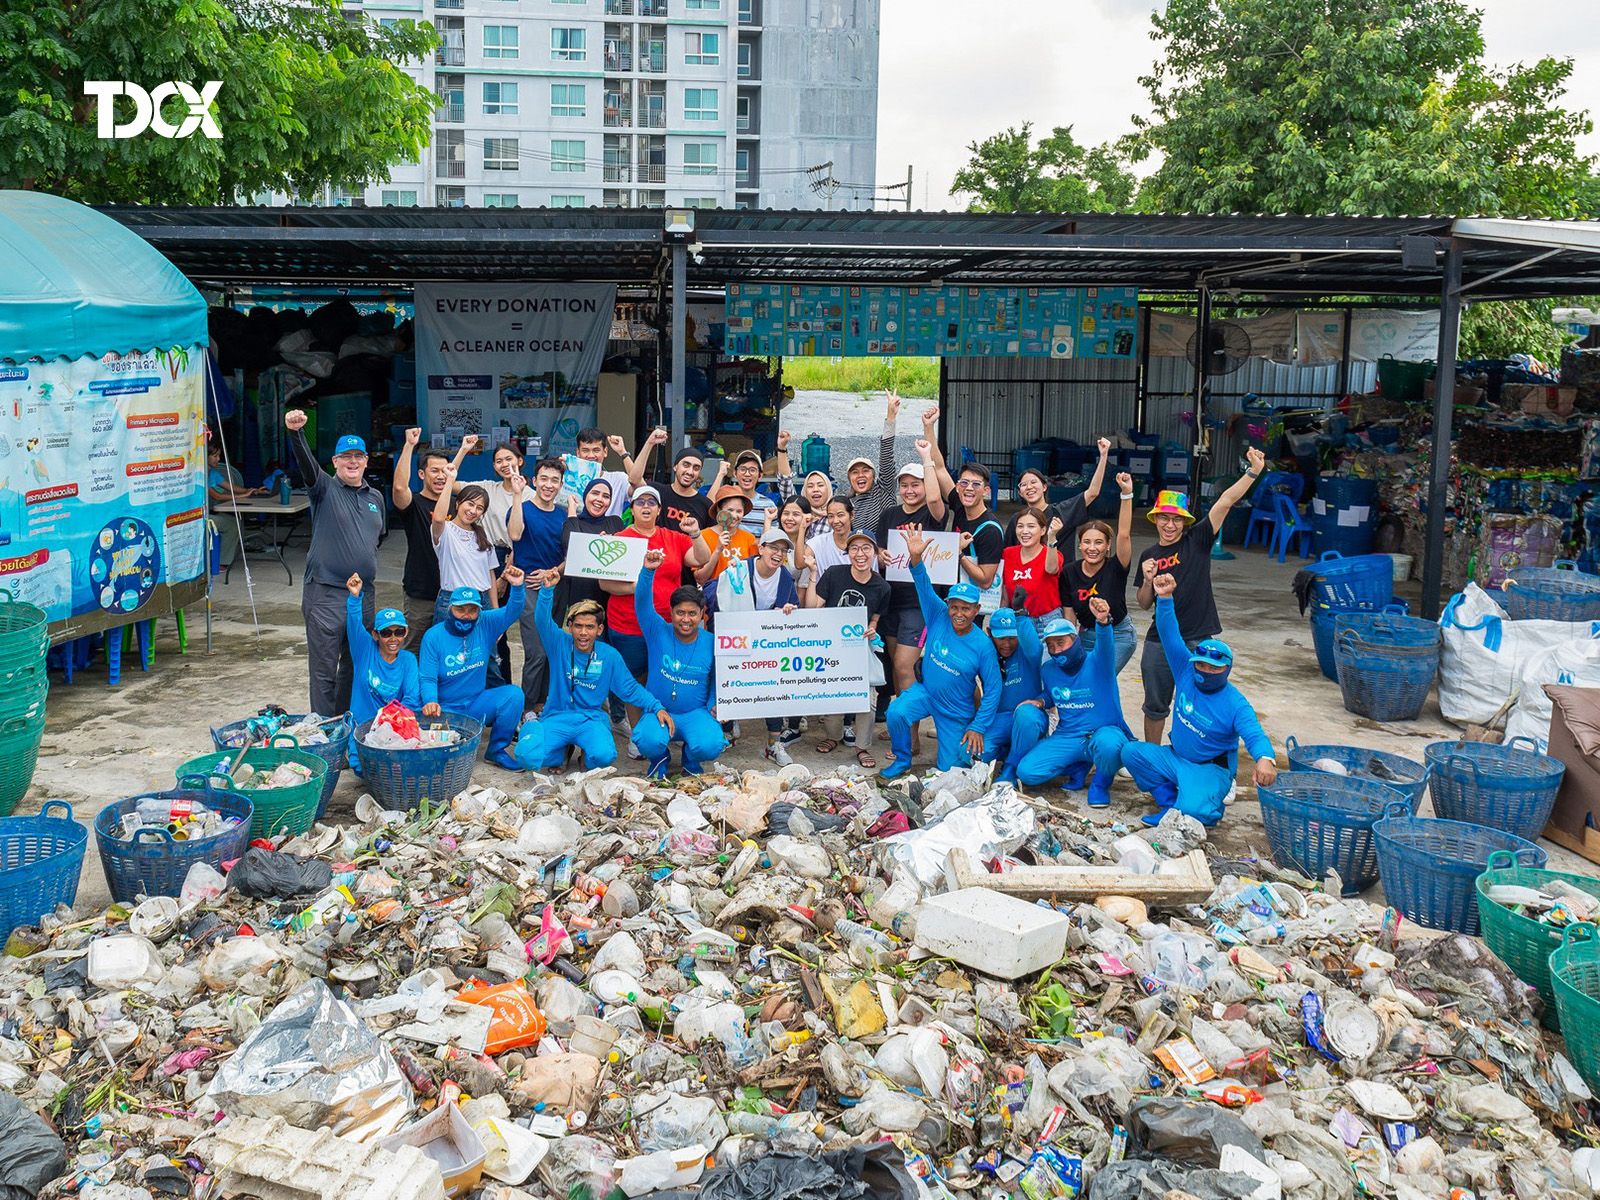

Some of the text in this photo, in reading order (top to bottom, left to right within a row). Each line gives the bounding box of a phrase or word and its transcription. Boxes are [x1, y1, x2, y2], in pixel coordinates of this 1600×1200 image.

[436, 298, 596, 313] EVERY DONATION
[439, 340, 584, 353] A CLEANER OCEAN
[581, 567, 629, 577] #BeGreener
[784, 623, 807, 631] Together
[717, 635, 748, 650] TDCX
[752, 637, 833, 650] #CanalCleanup
[741, 661, 778, 670] STOPPED
[780, 656, 826, 673] 2092
[824, 657, 840, 667] Kgs
[721, 680, 730, 688] of
[730, 678, 779, 688] #Oceanwaste,
[797, 675, 827, 685] polluting
[840, 675, 864, 683] oceans
[718, 697, 732, 706] Stop
[733, 696, 753, 704] Ocean
[753, 695, 776, 704] plastics
